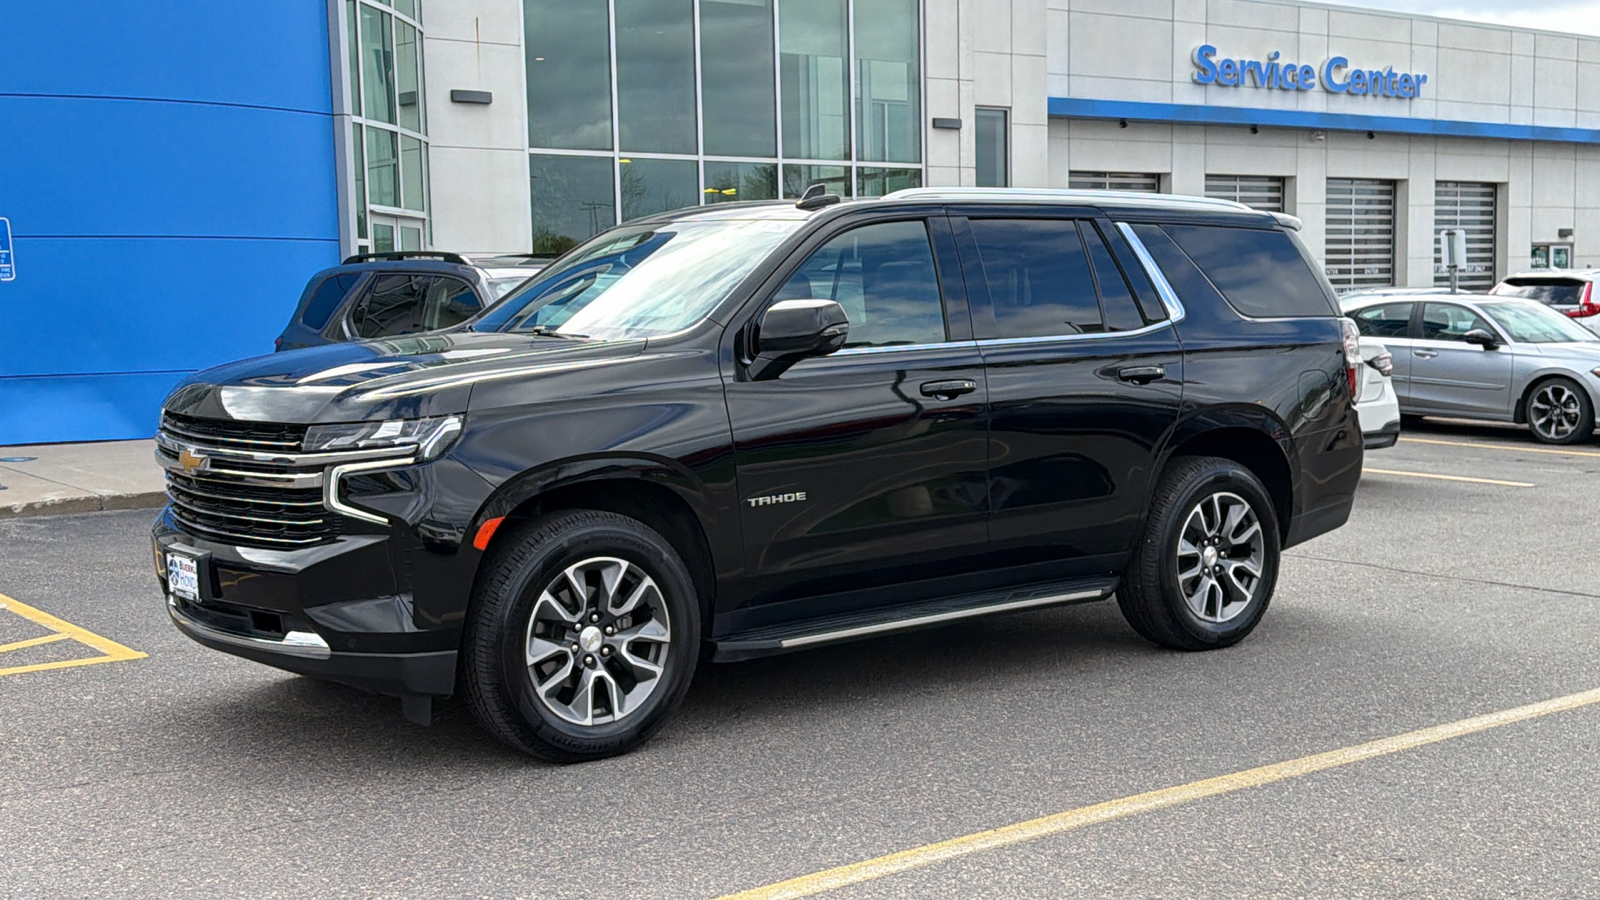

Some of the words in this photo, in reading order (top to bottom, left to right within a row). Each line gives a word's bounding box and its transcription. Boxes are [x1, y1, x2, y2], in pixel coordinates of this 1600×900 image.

[1193, 44, 1316, 91] Service
[1320, 56, 1428, 98] Center
[747, 491, 807, 507] TAHOE
[180, 571, 197, 590] HOND
